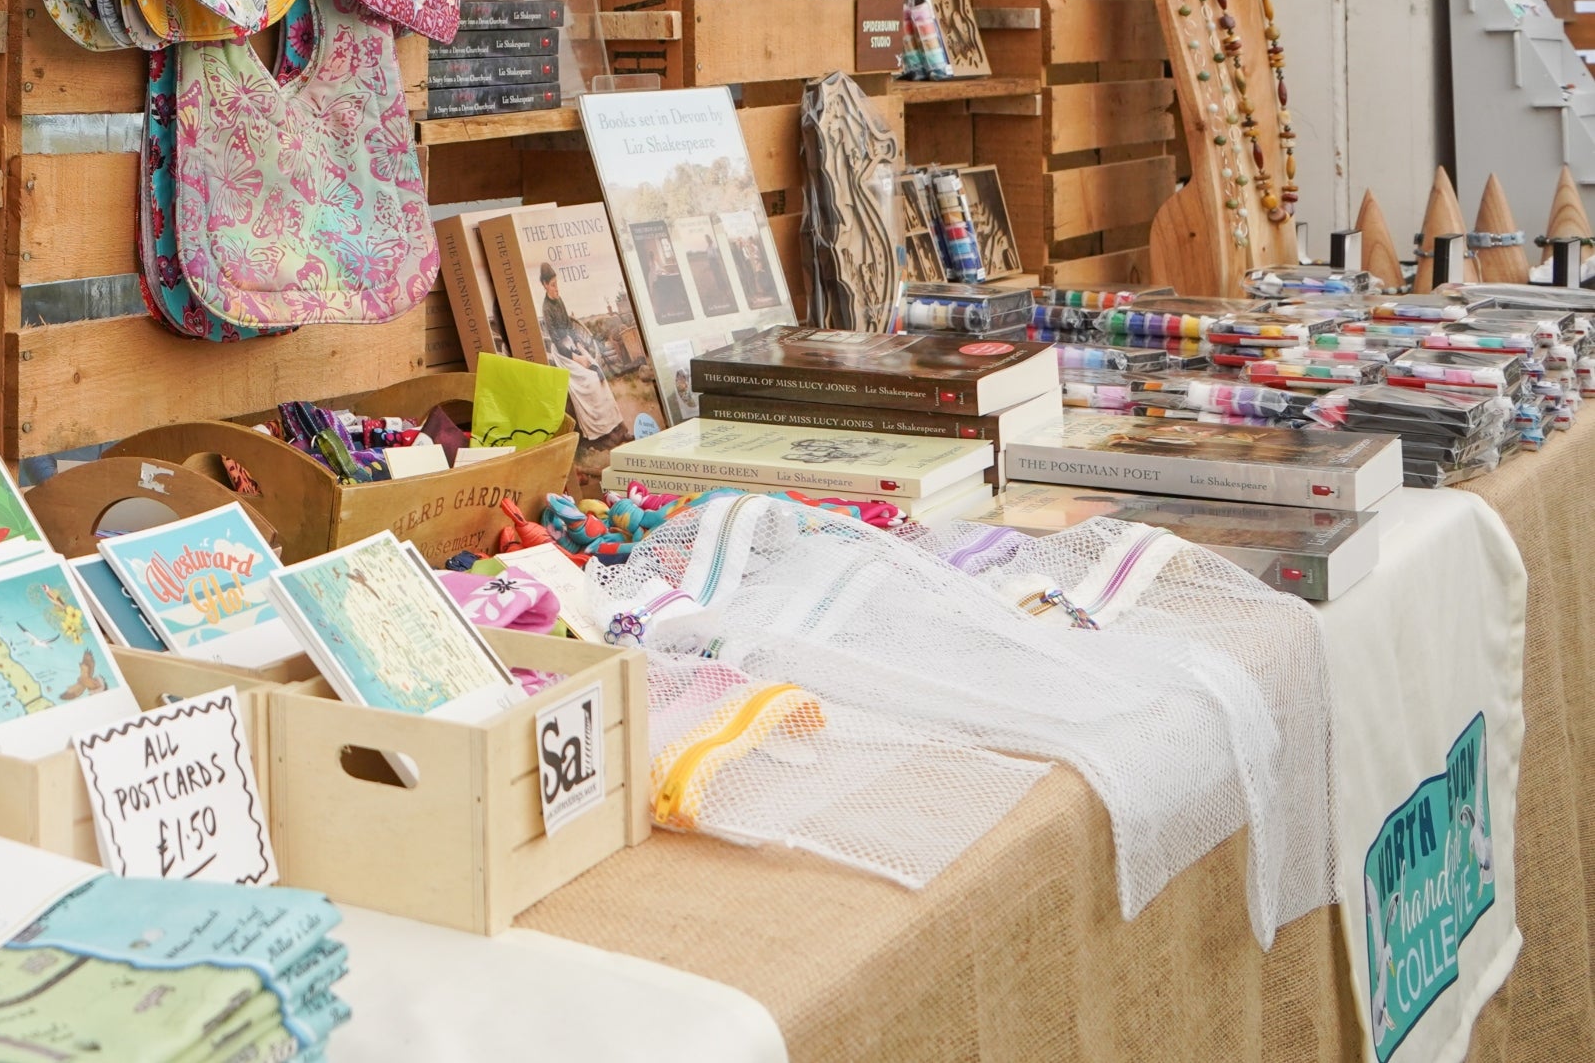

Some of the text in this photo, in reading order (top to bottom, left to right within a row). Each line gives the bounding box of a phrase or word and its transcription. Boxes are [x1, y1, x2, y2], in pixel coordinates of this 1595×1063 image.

[862, 19, 900, 33] SPIDERBUNNY
[504, 40, 531, 49] Shakespeare
[870, 35, 892, 49] STUDIO
[506, 68, 532, 78] Shakespeare
[509, 95, 535, 105] Shakespeare
[597, 104, 724, 131] Books set in Devon by
[622, 135, 717, 156] Liz Shakespeare
[522, 217, 604, 243] THE TURNING
[547, 242, 591, 262] OF THE
[559, 264, 590, 284] TIDE
[445, 233, 486, 354] THE TURNING OF TH
[494, 233, 535, 362] THE TURNING OF THE
[704, 373, 927, 398] THE ORDEAL OF MISS LUCY JONES Liz Shakespeare
[713, 409, 947, 434] THE ORDEAL OF MISS LUCY JONES Liz Shakespeare
[624, 457, 853, 487] THE MEMORY BE GREEN Liz Shakespeare
[641, 478, 692, 492] MEMORY
[1018, 458, 1268, 491] THE POSTMAN POET Liz Shakespeare
[393, 486, 522, 537] HERB GARDEN
[420, 529, 486, 559] Rosemary
[145, 545, 255, 603] Westward
[188, 572, 252, 625] Ho!
[145, 731, 179, 769] ALL
[541, 699, 596, 805] Sal
[113, 753, 226, 821] POSTCARDS
[1377, 738, 1476, 908] NORTH EVON
[156, 805, 217, 878] £1.50
